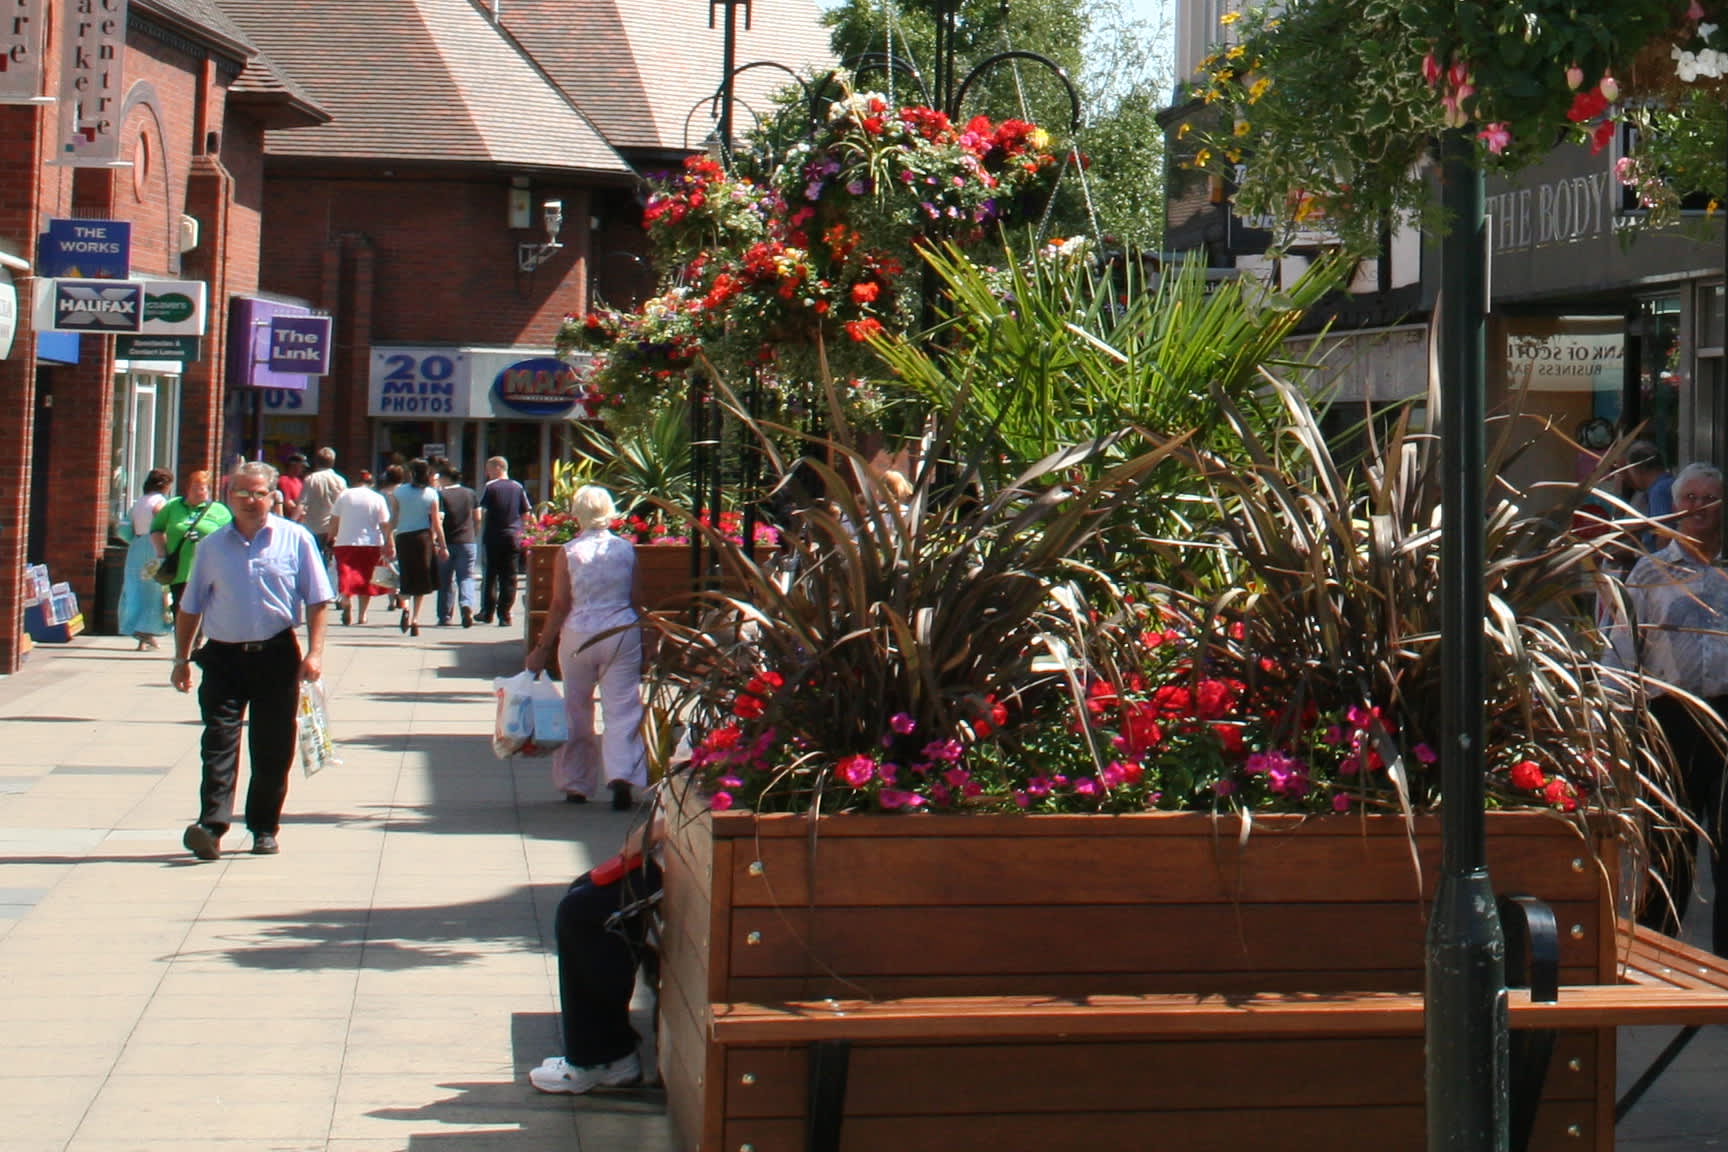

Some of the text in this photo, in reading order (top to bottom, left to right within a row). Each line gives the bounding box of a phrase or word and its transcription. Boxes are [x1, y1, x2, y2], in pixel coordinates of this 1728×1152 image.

[1485, 171, 1610, 250] THE BODY
[74, 227, 107, 239] THE
[60, 242, 120, 253] WORKS
[60, 299, 135, 314] HALIFAX
[275, 330, 318, 343] The
[273, 348, 320, 360] Link
[384, 355, 454, 380] 20
[383, 381, 454, 395] MIN
[380, 396, 454, 413] PHOTOS
